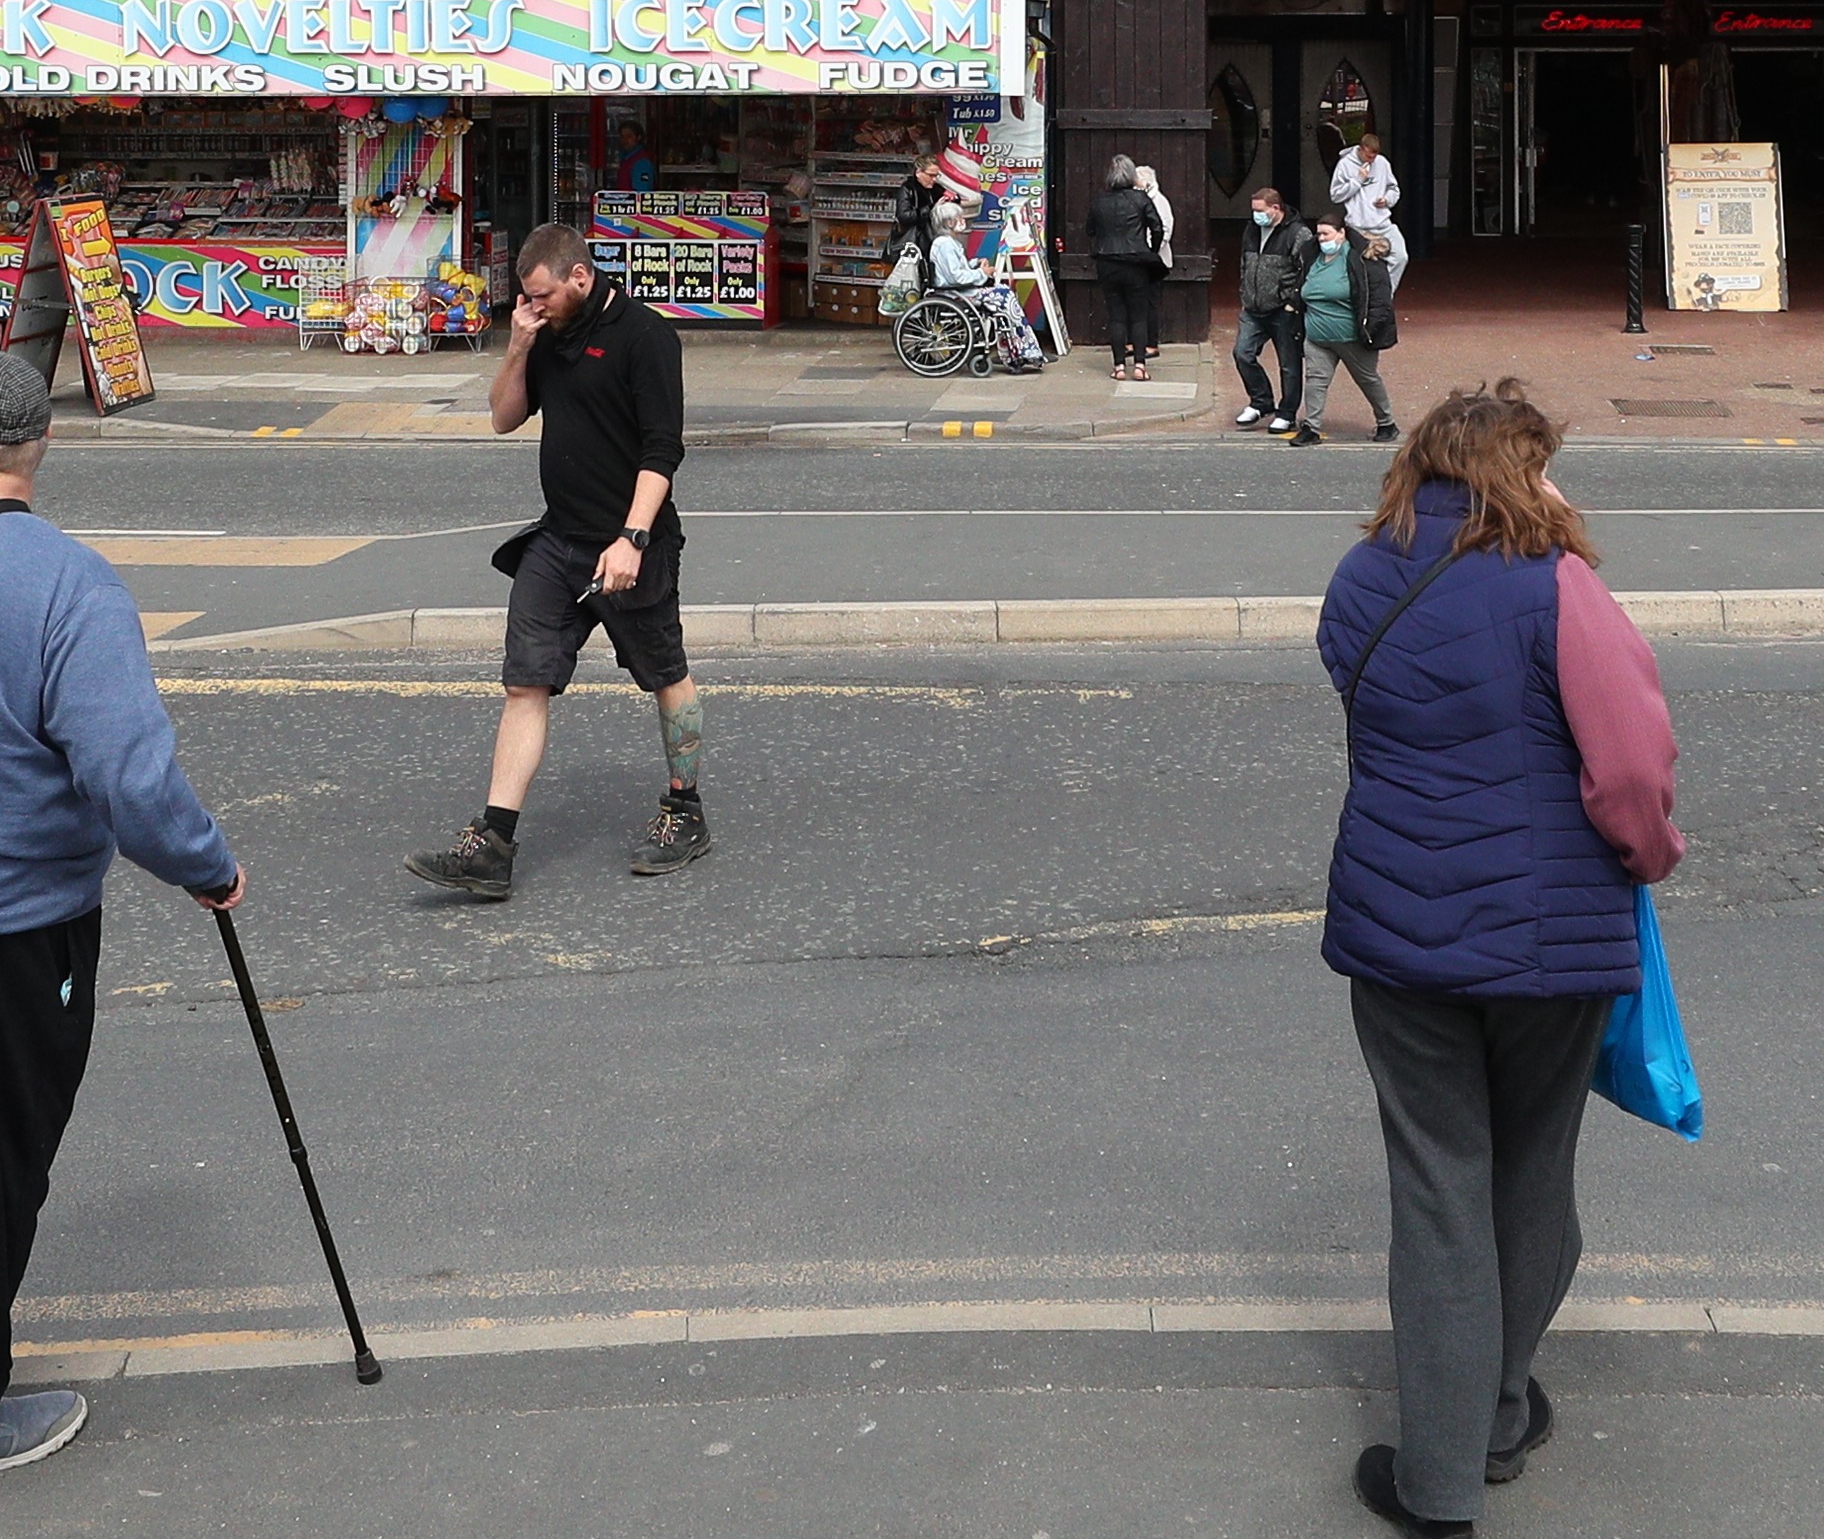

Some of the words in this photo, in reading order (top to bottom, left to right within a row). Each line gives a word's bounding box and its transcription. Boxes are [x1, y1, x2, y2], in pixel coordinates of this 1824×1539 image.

[1541, 10, 1644, 32] Entrance
[1713, 11, 1814, 32] Entrance
[84, 64, 266, 93] DRINKS
[323, 63, 484, 92] SLUSH
[552, 63, 759, 91] NOUGAT
[819, 61, 989, 90] FUDGE
[953, 107, 972, 119] Tub
[982, 156, 1044, 168] Cream
[1012, 184, 1043, 196] Ice
[60, 226, 70, 242] I
[73, 209, 106, 238] FOOD
[634, 245, 642, 257] 8
[644, 245, 667, 258] Bars
[675, 245, 688, 257] 20
[690, 245, 713, 258] Bars
[721, 245, 755, 260] Variety
[632, 259, 644, 272] of
[645, 259, 669, 272] Rock
[676, 259, 687, 272] of
[688, 259, 712, 272] Rock
[79, 265, 113, 284] Burgers
[641, 275, 656, 286] Only
[261, 275, 343, 289] FLOSS
[684, 276, 700, 287] Only
[727, 276, 743, 287] Only
[120, 259, 251, 318] OCK
[633, 285, 669, 298] £1.25
[675, 286, 712, 298] £1.25
[719, 287, 756, 298] £1.00
